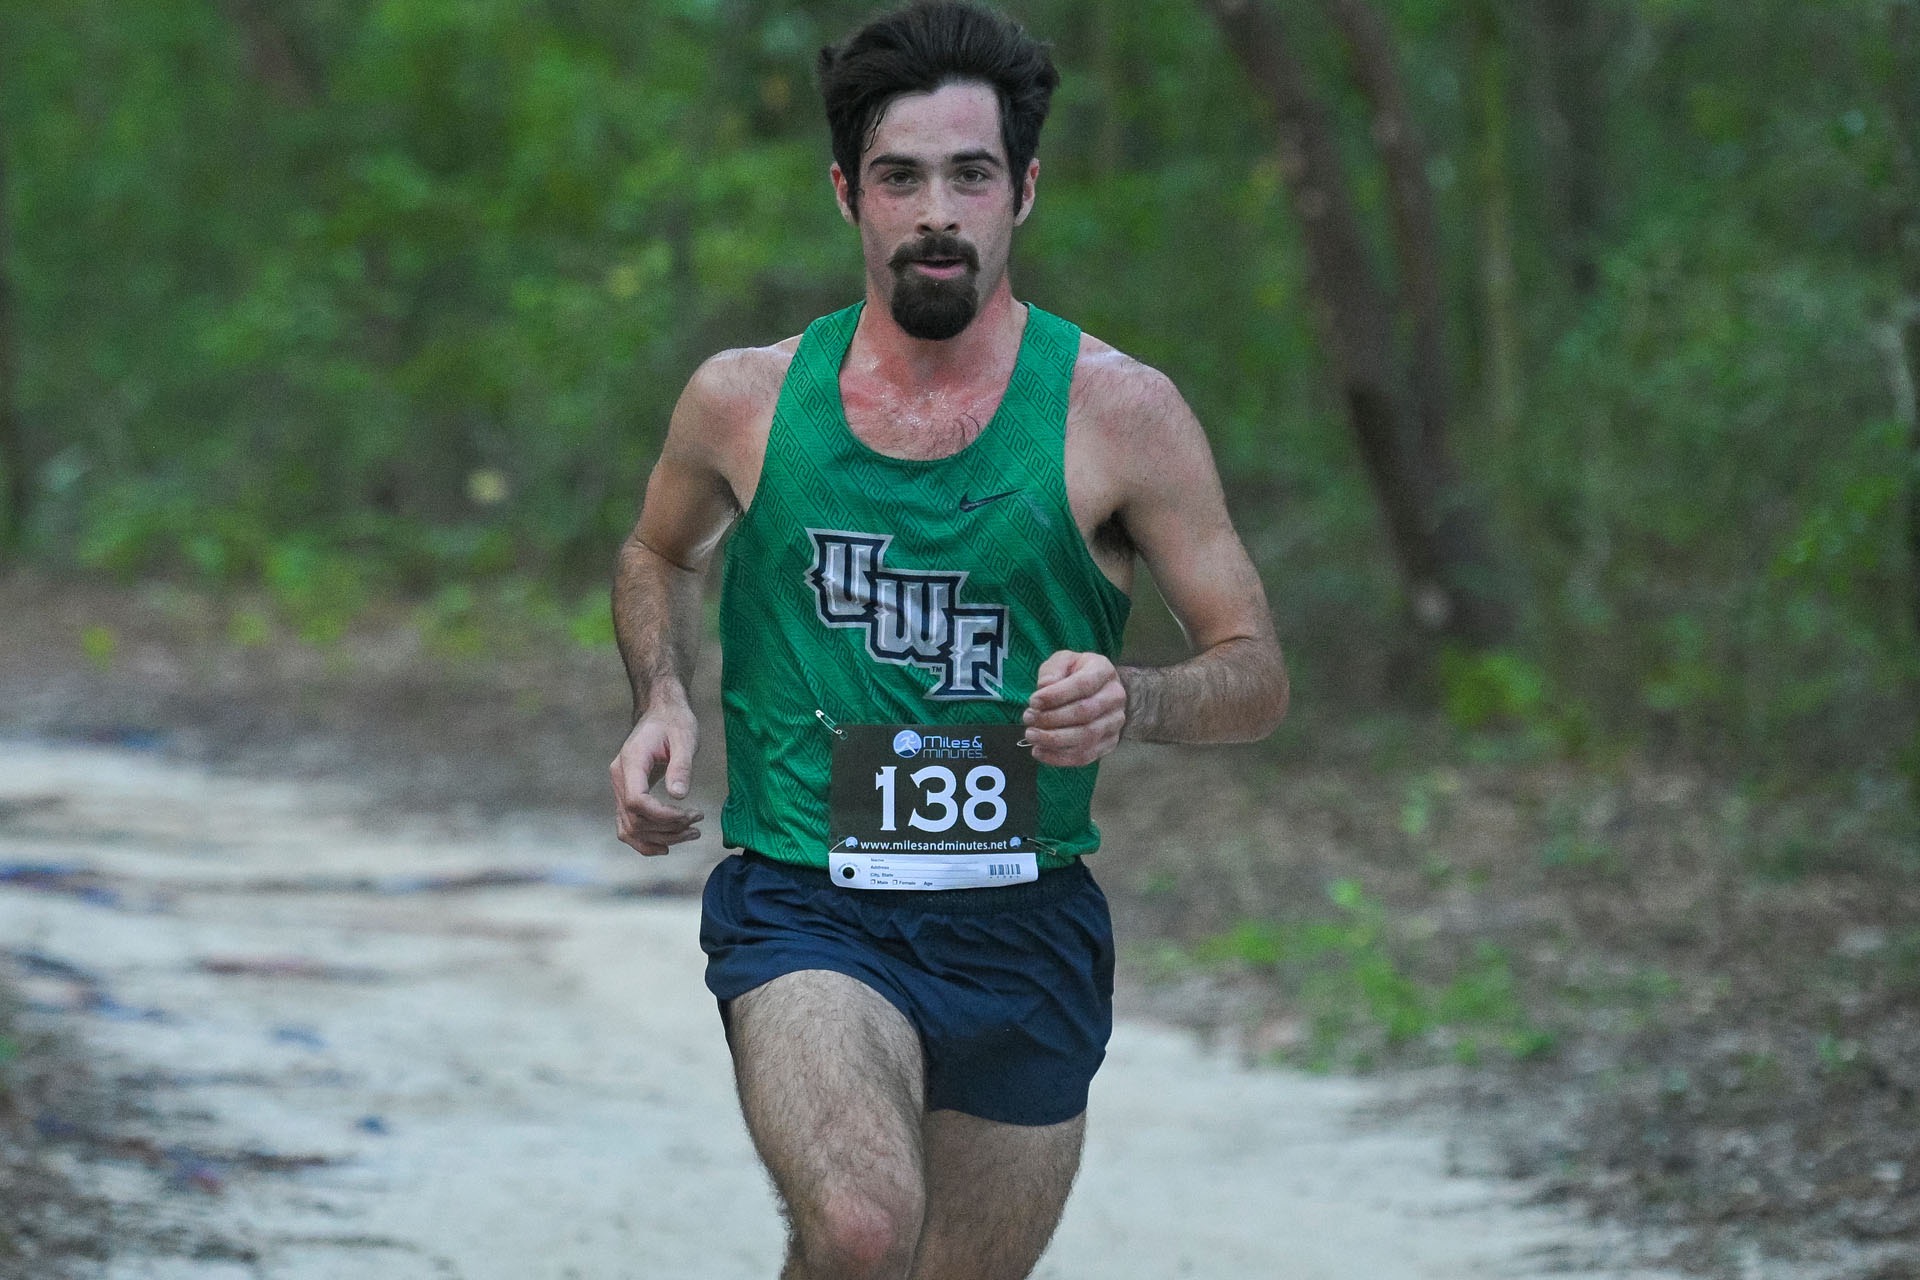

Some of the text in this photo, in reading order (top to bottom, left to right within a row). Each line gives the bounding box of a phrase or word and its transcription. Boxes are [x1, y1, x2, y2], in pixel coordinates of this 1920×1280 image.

[804, 527, 1009, 700] UWF
[923, 735, 983, 749] Miles &
[875, 765, 1008, 833] 138
[860, 839, 1008, 851] www.milesandminutes.net
